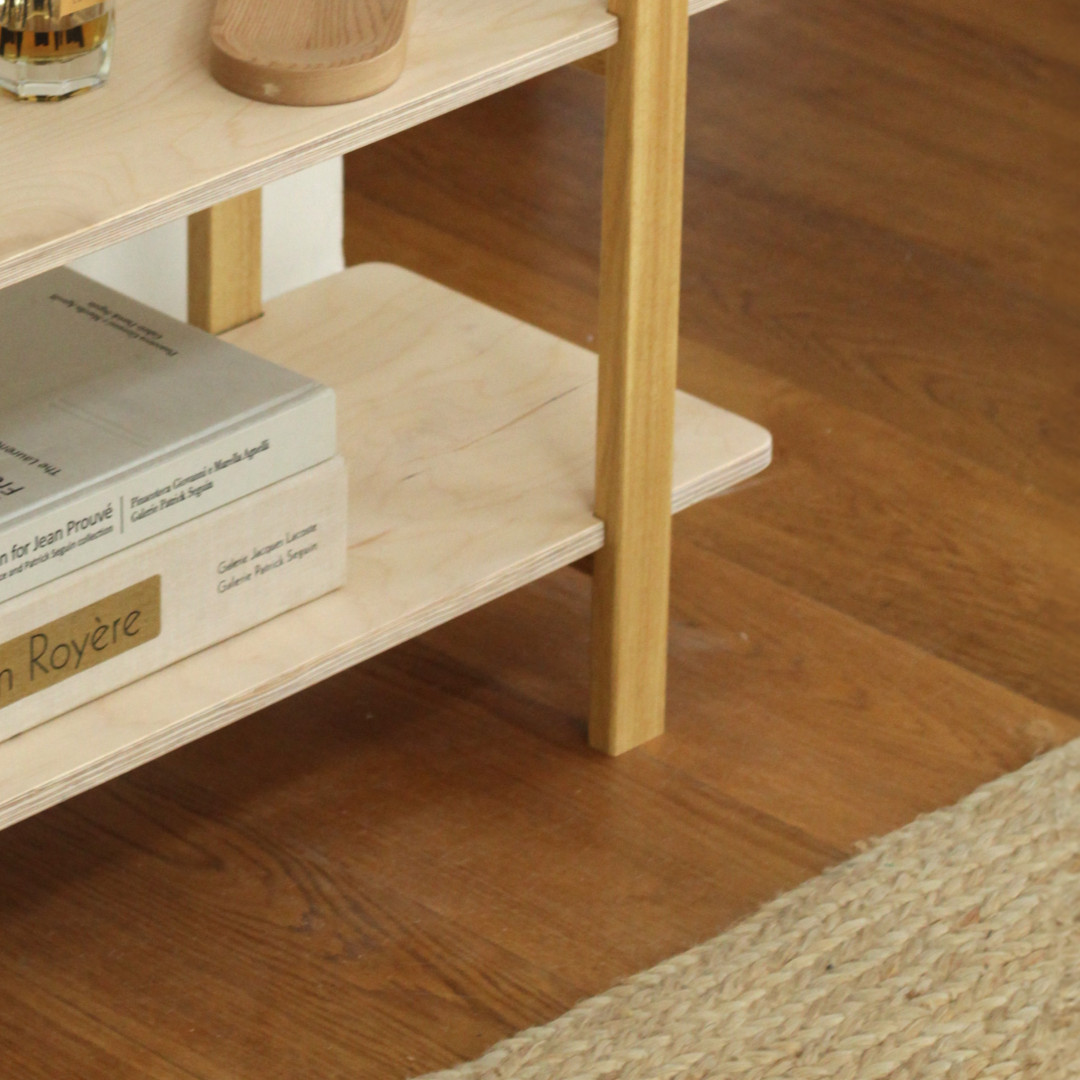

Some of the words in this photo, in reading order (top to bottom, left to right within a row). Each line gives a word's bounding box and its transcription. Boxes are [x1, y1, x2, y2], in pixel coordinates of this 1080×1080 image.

[37, 461, 62, 477] The
[11, 541, 31, 561] for
[33, 527, 63, 552] Jean
[66, 502, 114, 536] Prouvé
[29, 610, 142, 682] Royère
